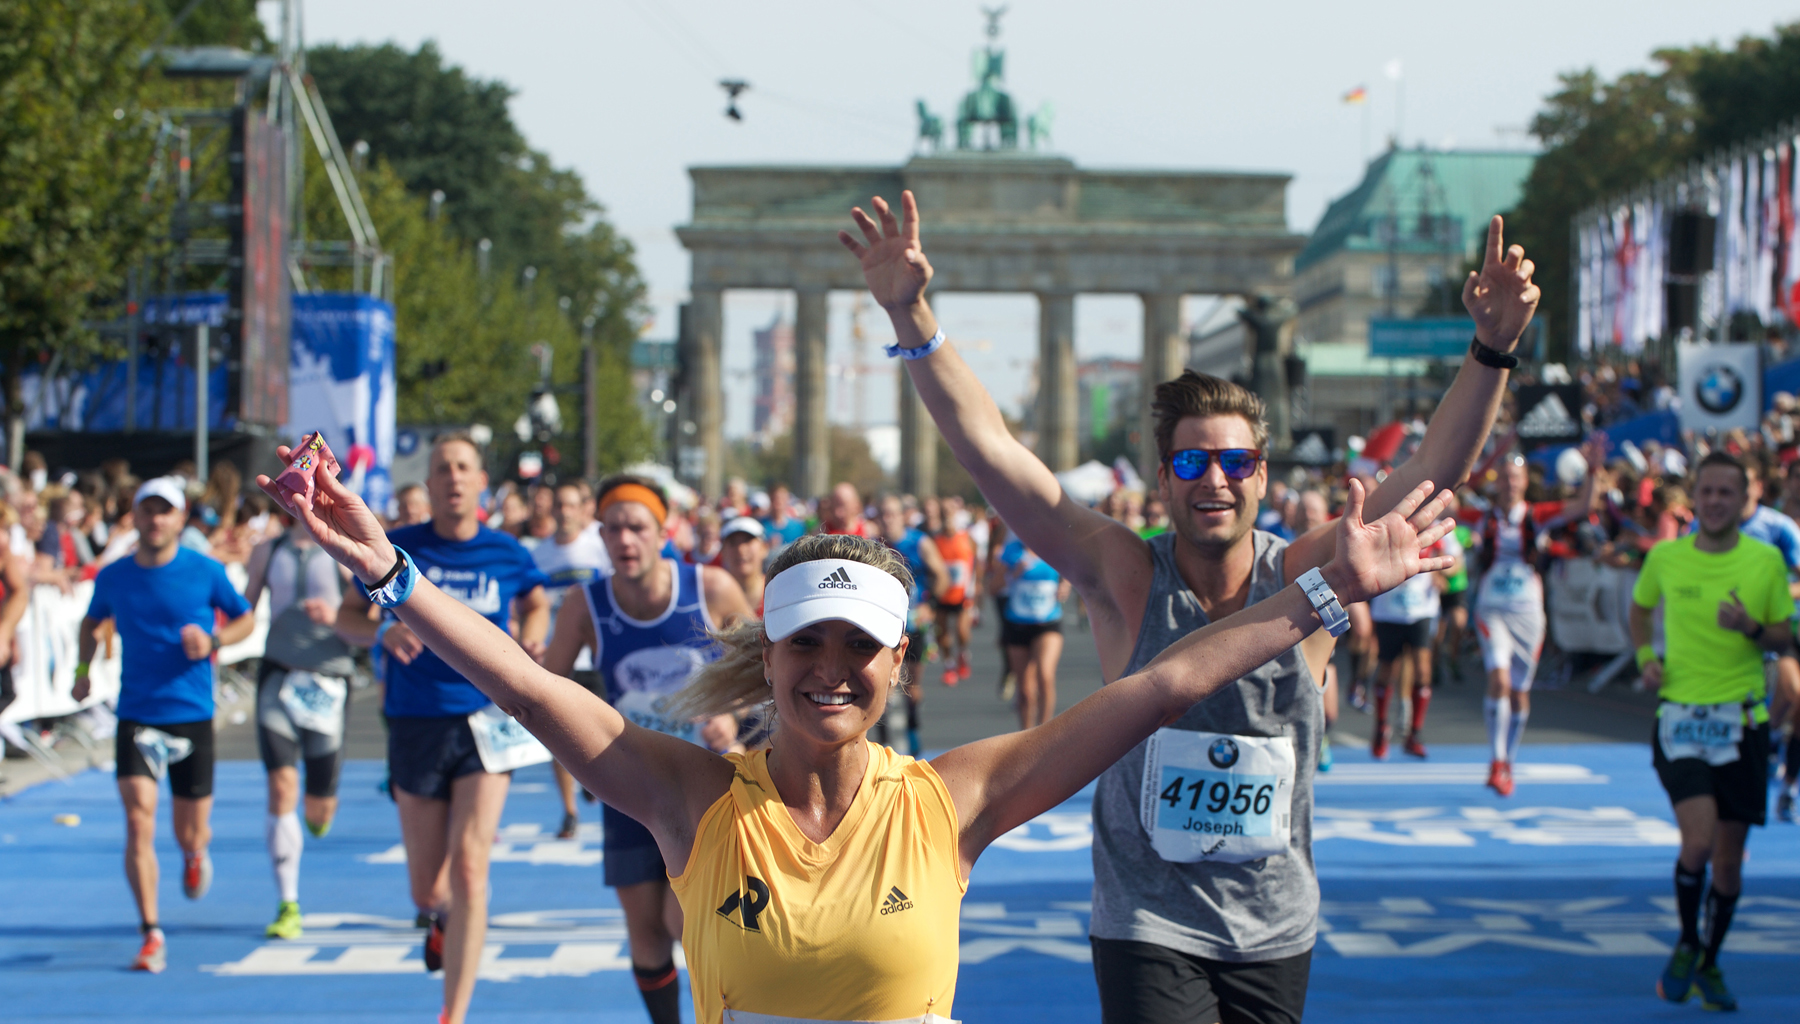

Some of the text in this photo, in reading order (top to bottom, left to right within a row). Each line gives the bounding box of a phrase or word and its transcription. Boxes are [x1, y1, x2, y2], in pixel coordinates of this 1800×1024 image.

[818, 581, 858, 590] adidas
[1279, 778, 1287, 789] F
[1160, 776, 1273, 815] 41956
[1182, 817, 1244, 836] Joseph
[880, 900, 914, 916] adidas
